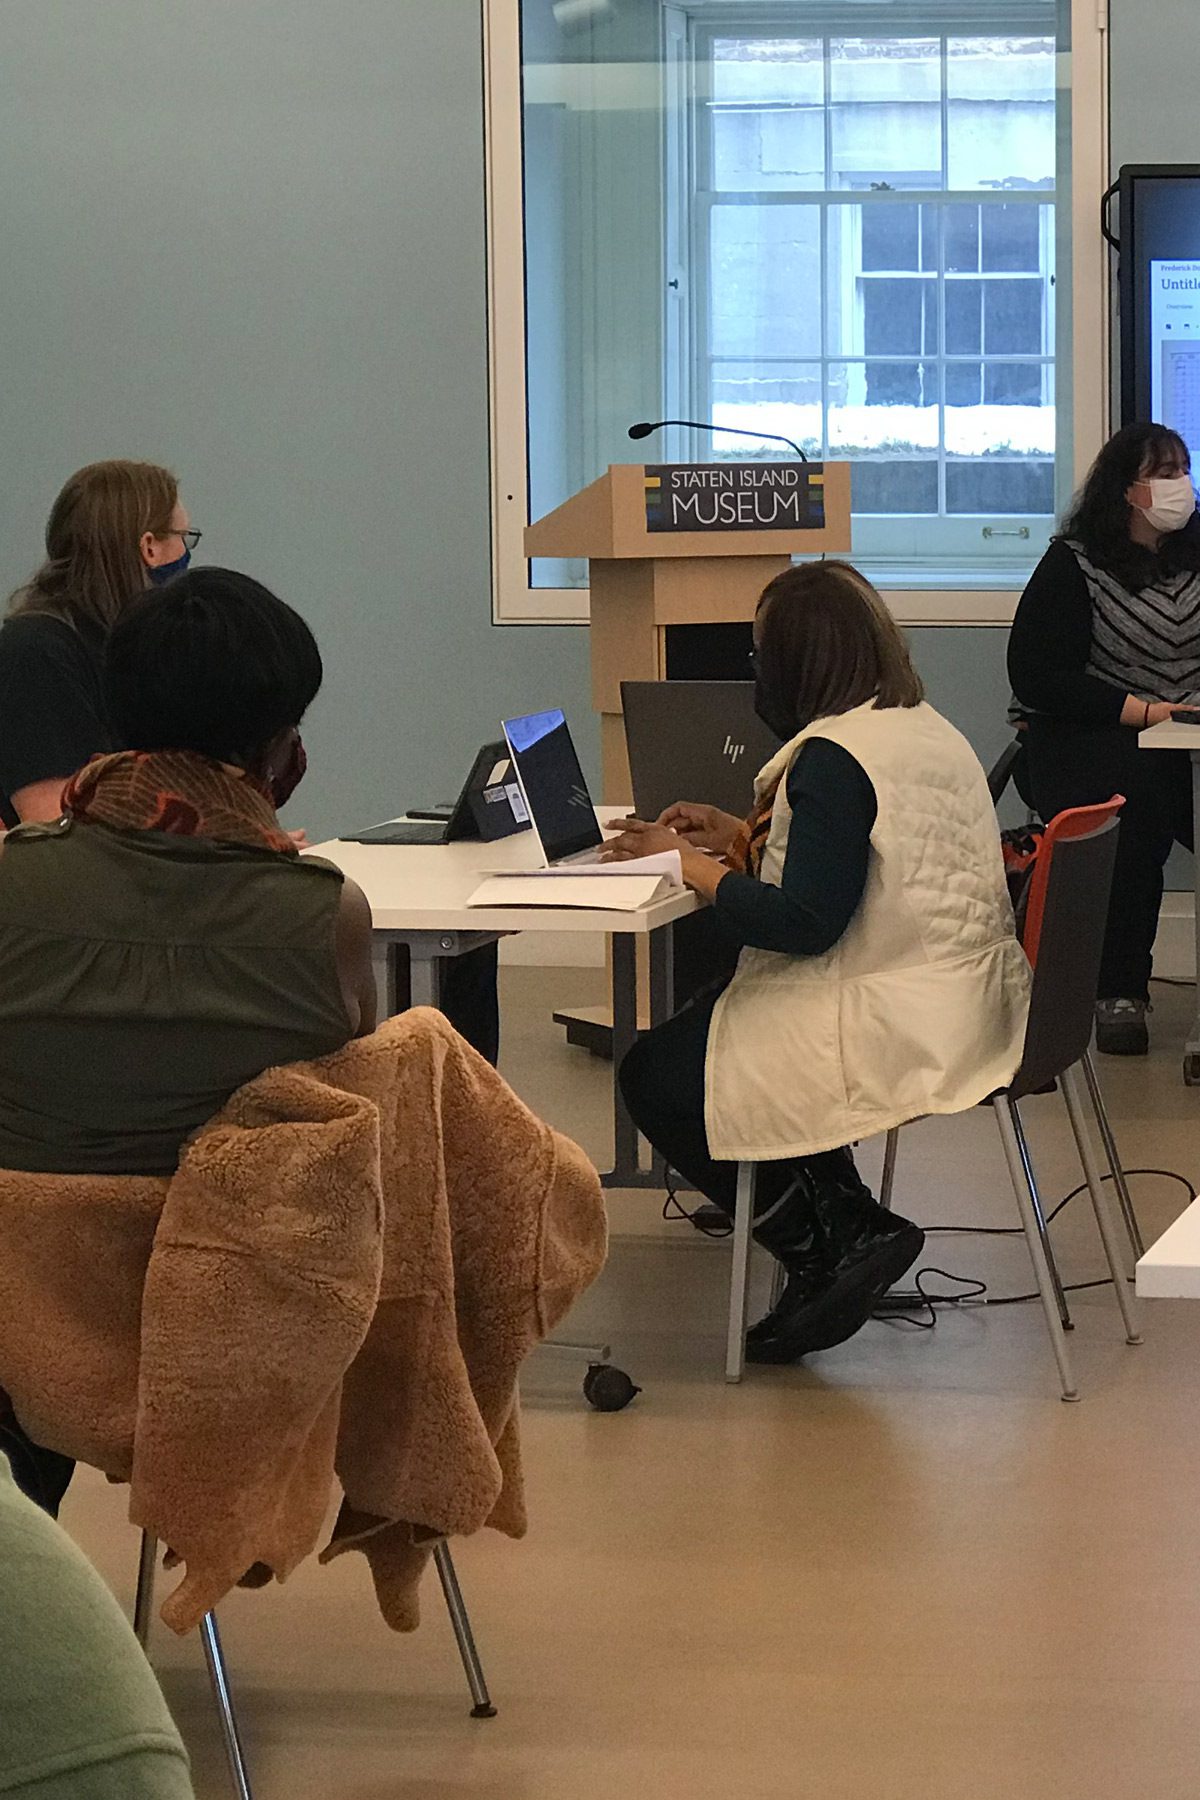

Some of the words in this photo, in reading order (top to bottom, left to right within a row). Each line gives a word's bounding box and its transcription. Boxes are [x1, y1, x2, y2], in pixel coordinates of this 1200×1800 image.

[671, 470, 734, 488] STATEN
[740, 469, 799, 487] ISLAND
[672, 491, 800, 525] MUSEUM
[723, 735, 745, 764] hp
